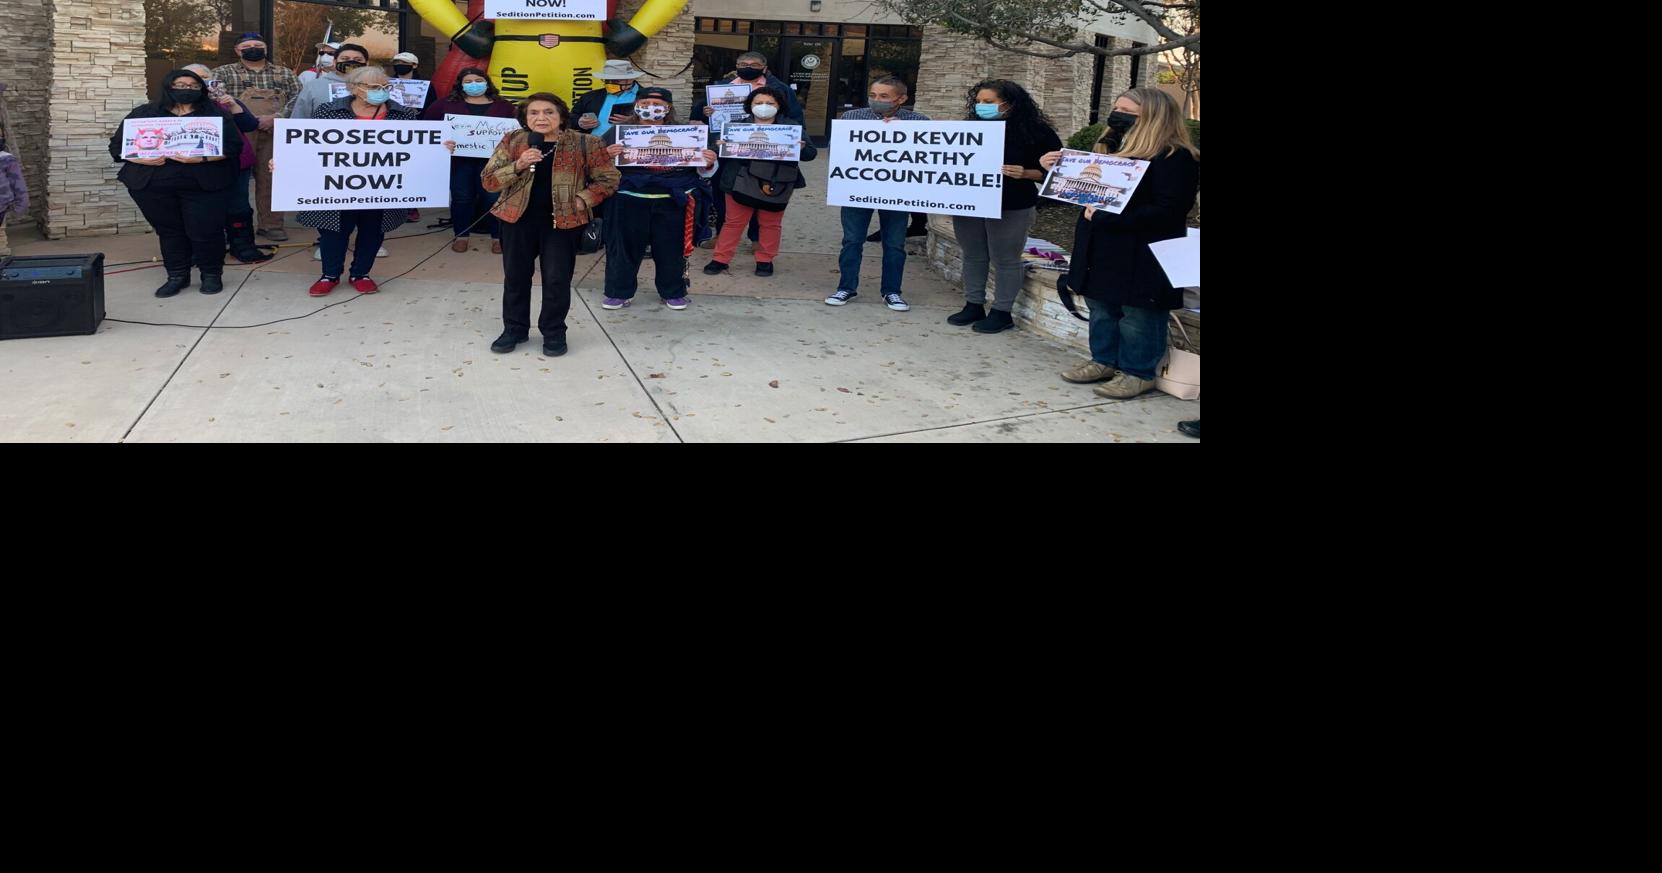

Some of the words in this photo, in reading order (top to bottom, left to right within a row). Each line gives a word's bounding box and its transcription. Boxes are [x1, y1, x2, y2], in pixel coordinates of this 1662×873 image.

[526, 0, 566, 8] NOW!
[496, 11, 595, 19] SeditionPetition.com
[501, 67, 529, 91] UP
[285, 128, 442, 145] PROSECUTE
[849, 129, 907, 144] HOLD
[913, 131, 983, 146] KEVIN
[318, 151, 411, 168] TRUMP
[854, 148, 976, 166] McCARTHY
[324, 174, 403, 190] NOW!
[829, 166, 1002, 188] ACCOUNTABLE!
[297, 195, 427, 205] SeditionPetition.com
[849, 195, 976, 211] SeditionPetition.com
